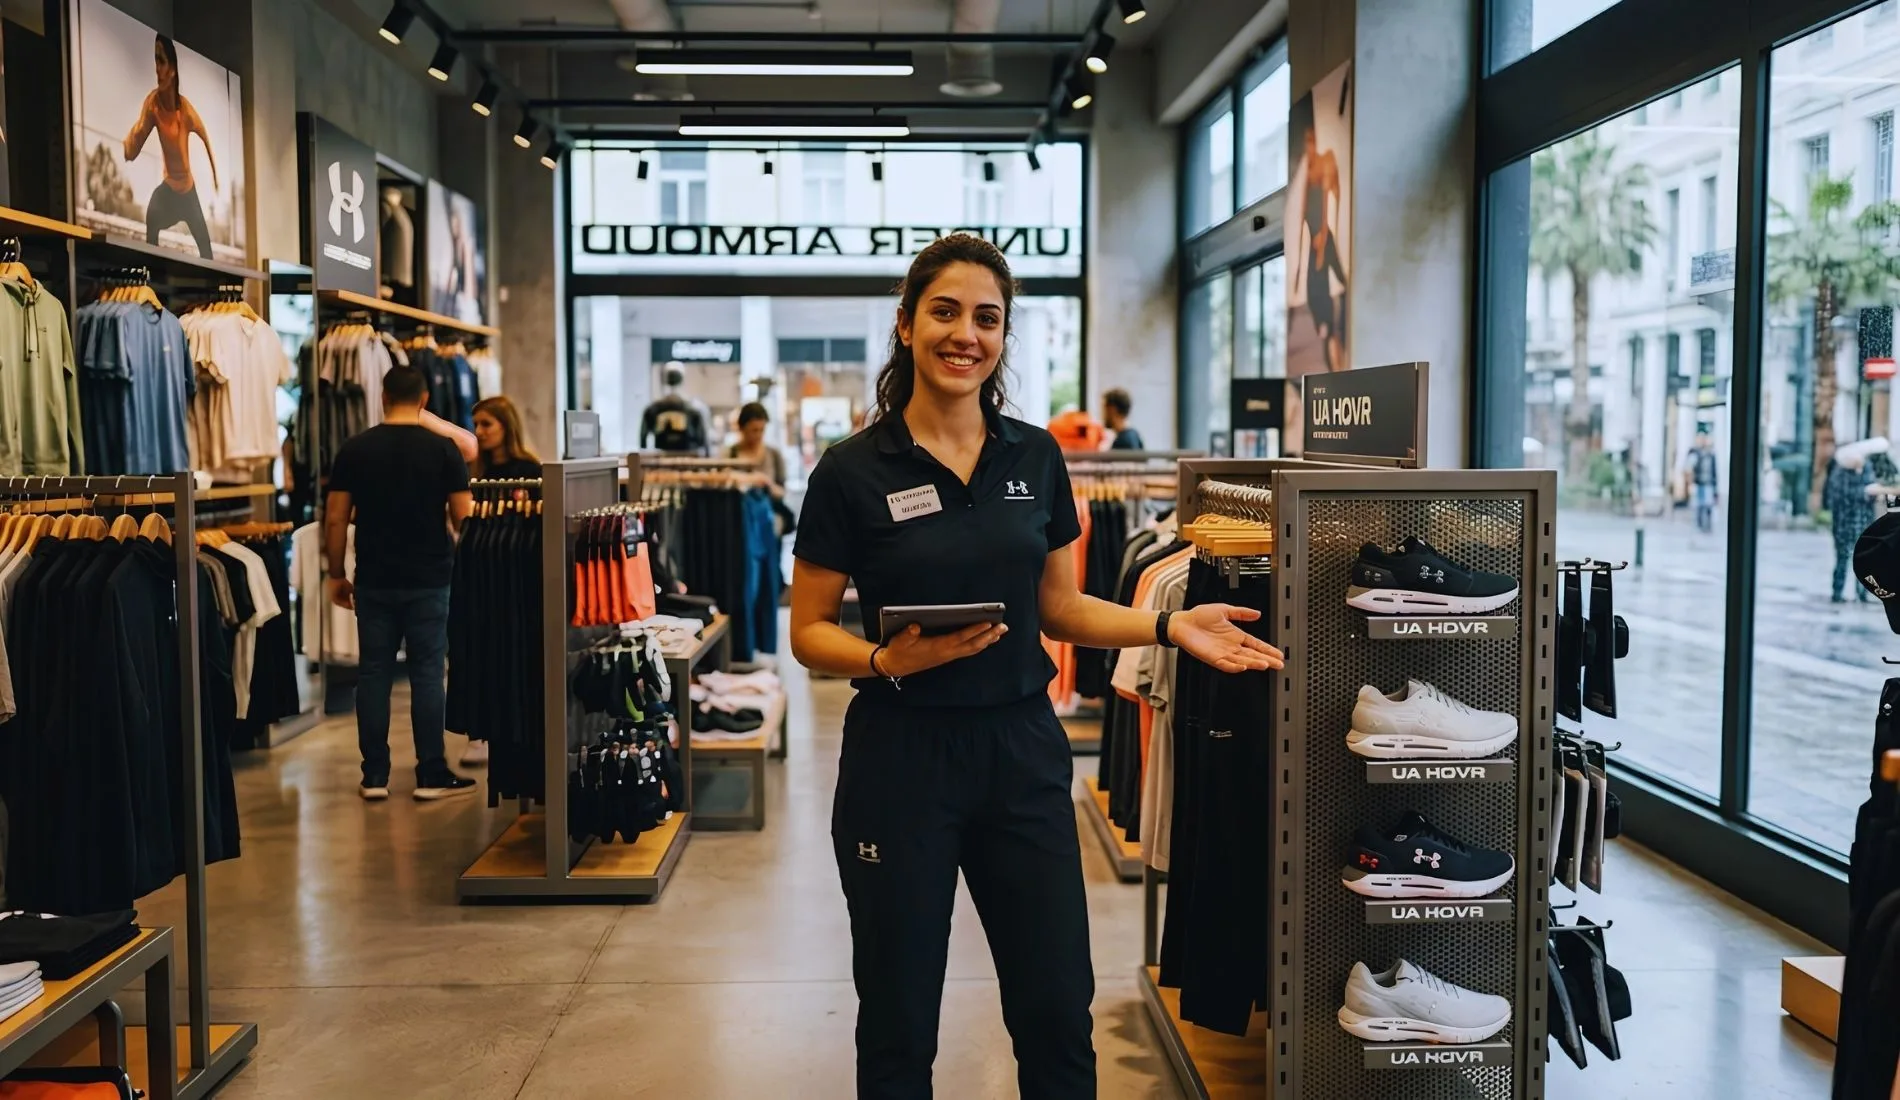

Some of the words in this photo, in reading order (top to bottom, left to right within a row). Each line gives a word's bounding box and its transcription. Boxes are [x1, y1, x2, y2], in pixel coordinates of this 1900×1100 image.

[1312, 399, 1330, 426] UA
[1332, 396, 1372, 426] HOVR
[1393, 622, 1423, 634] UA
[1391, 767, 1422, 780] UA
[1425, 766, 1486, 779] HOVR
[1391, 906, 1421, 919] UA
[1390, 1051, 1420, 1065] UA
